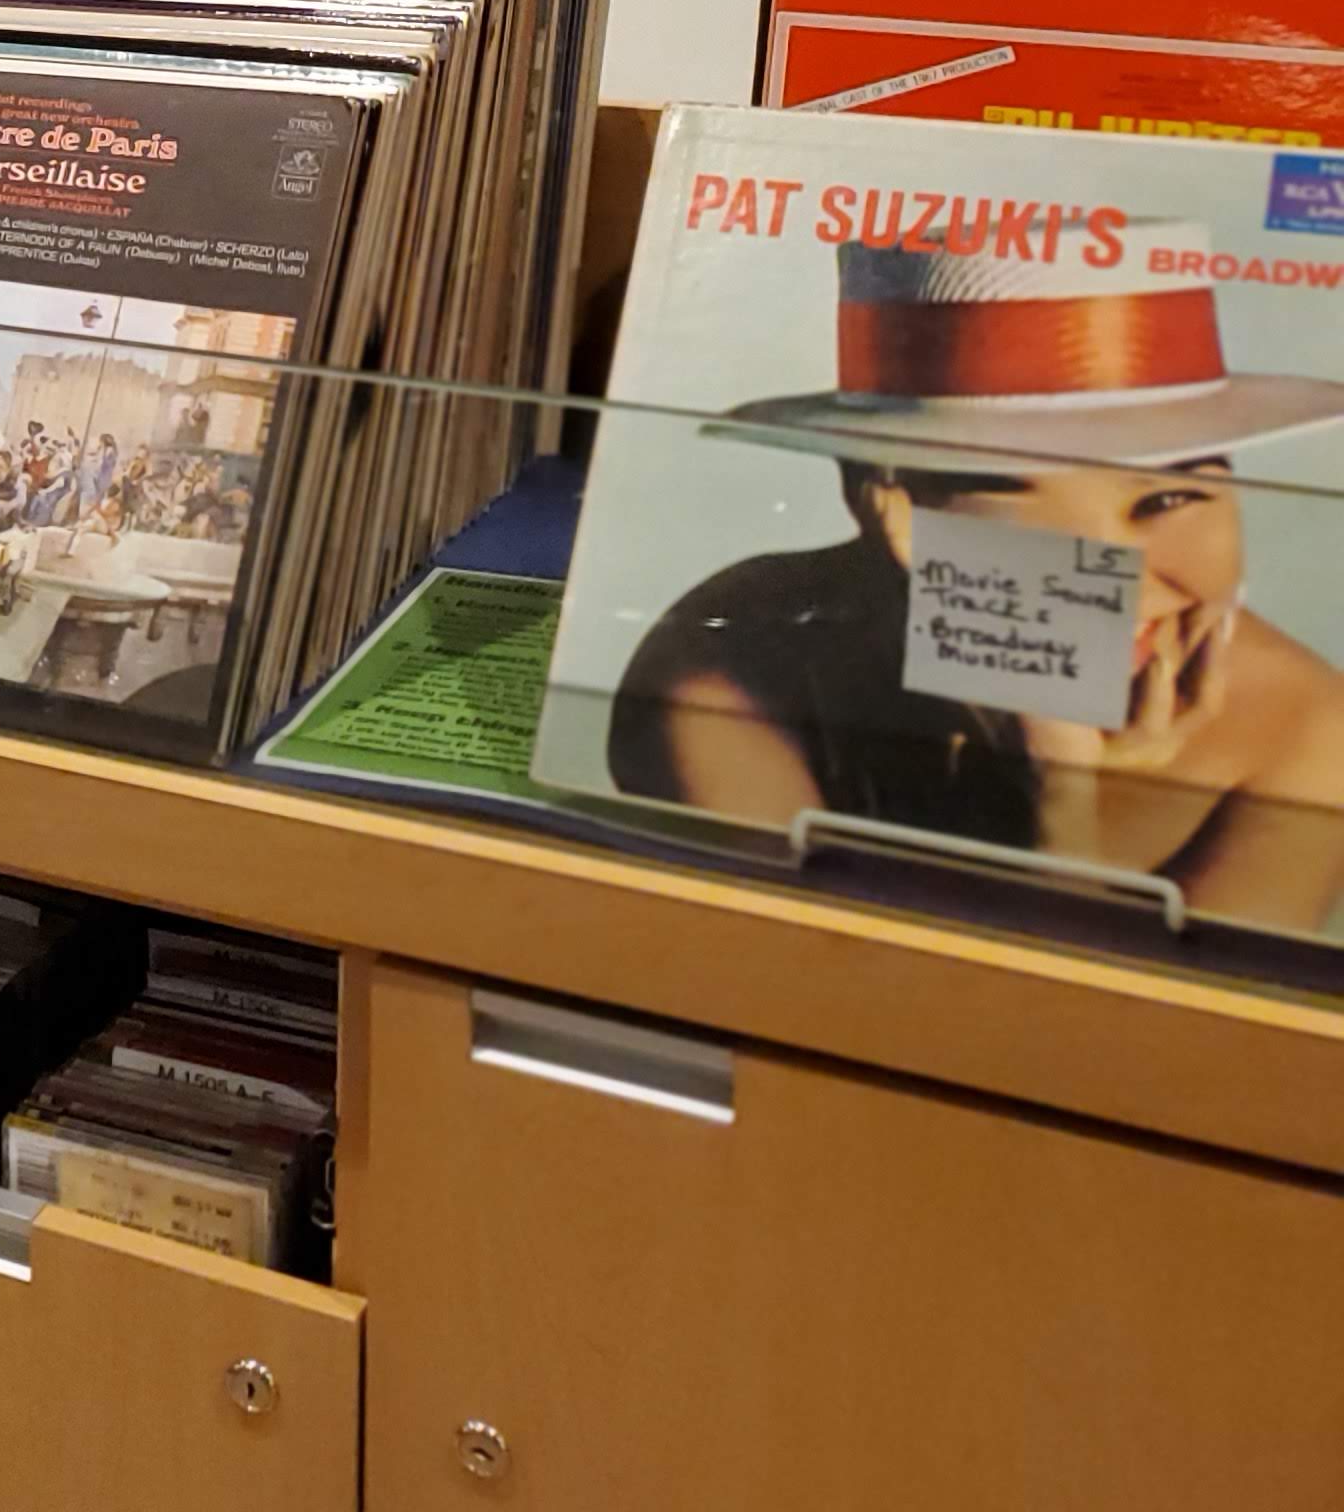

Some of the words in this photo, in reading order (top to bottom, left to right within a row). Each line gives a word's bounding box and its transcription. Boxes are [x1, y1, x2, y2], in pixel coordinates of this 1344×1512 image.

[941, 50, 1009, 77] PRODUCTION
[1, 106, 37, 120] great
[40, 112, 70, 122] new
[18, 97, 92, 112] recordings
[41, 125, 80, 151] de
[86, 127, 178, 160] Paris
[686, 173, 803, 238] PAT
[815, 185, 1129, 270] SUZUKI'S
[58, 238, 74, 249] OF
[76, 240, 86, 251] A
[215, 241, 274, 258] SCHERZO
[1042, 574, 1123, 614] Sound
[930, 615, 1077, 658] Broadway
[937, 641, 1079, 679] Musicals
[158, 1063, 175, 1080] M
